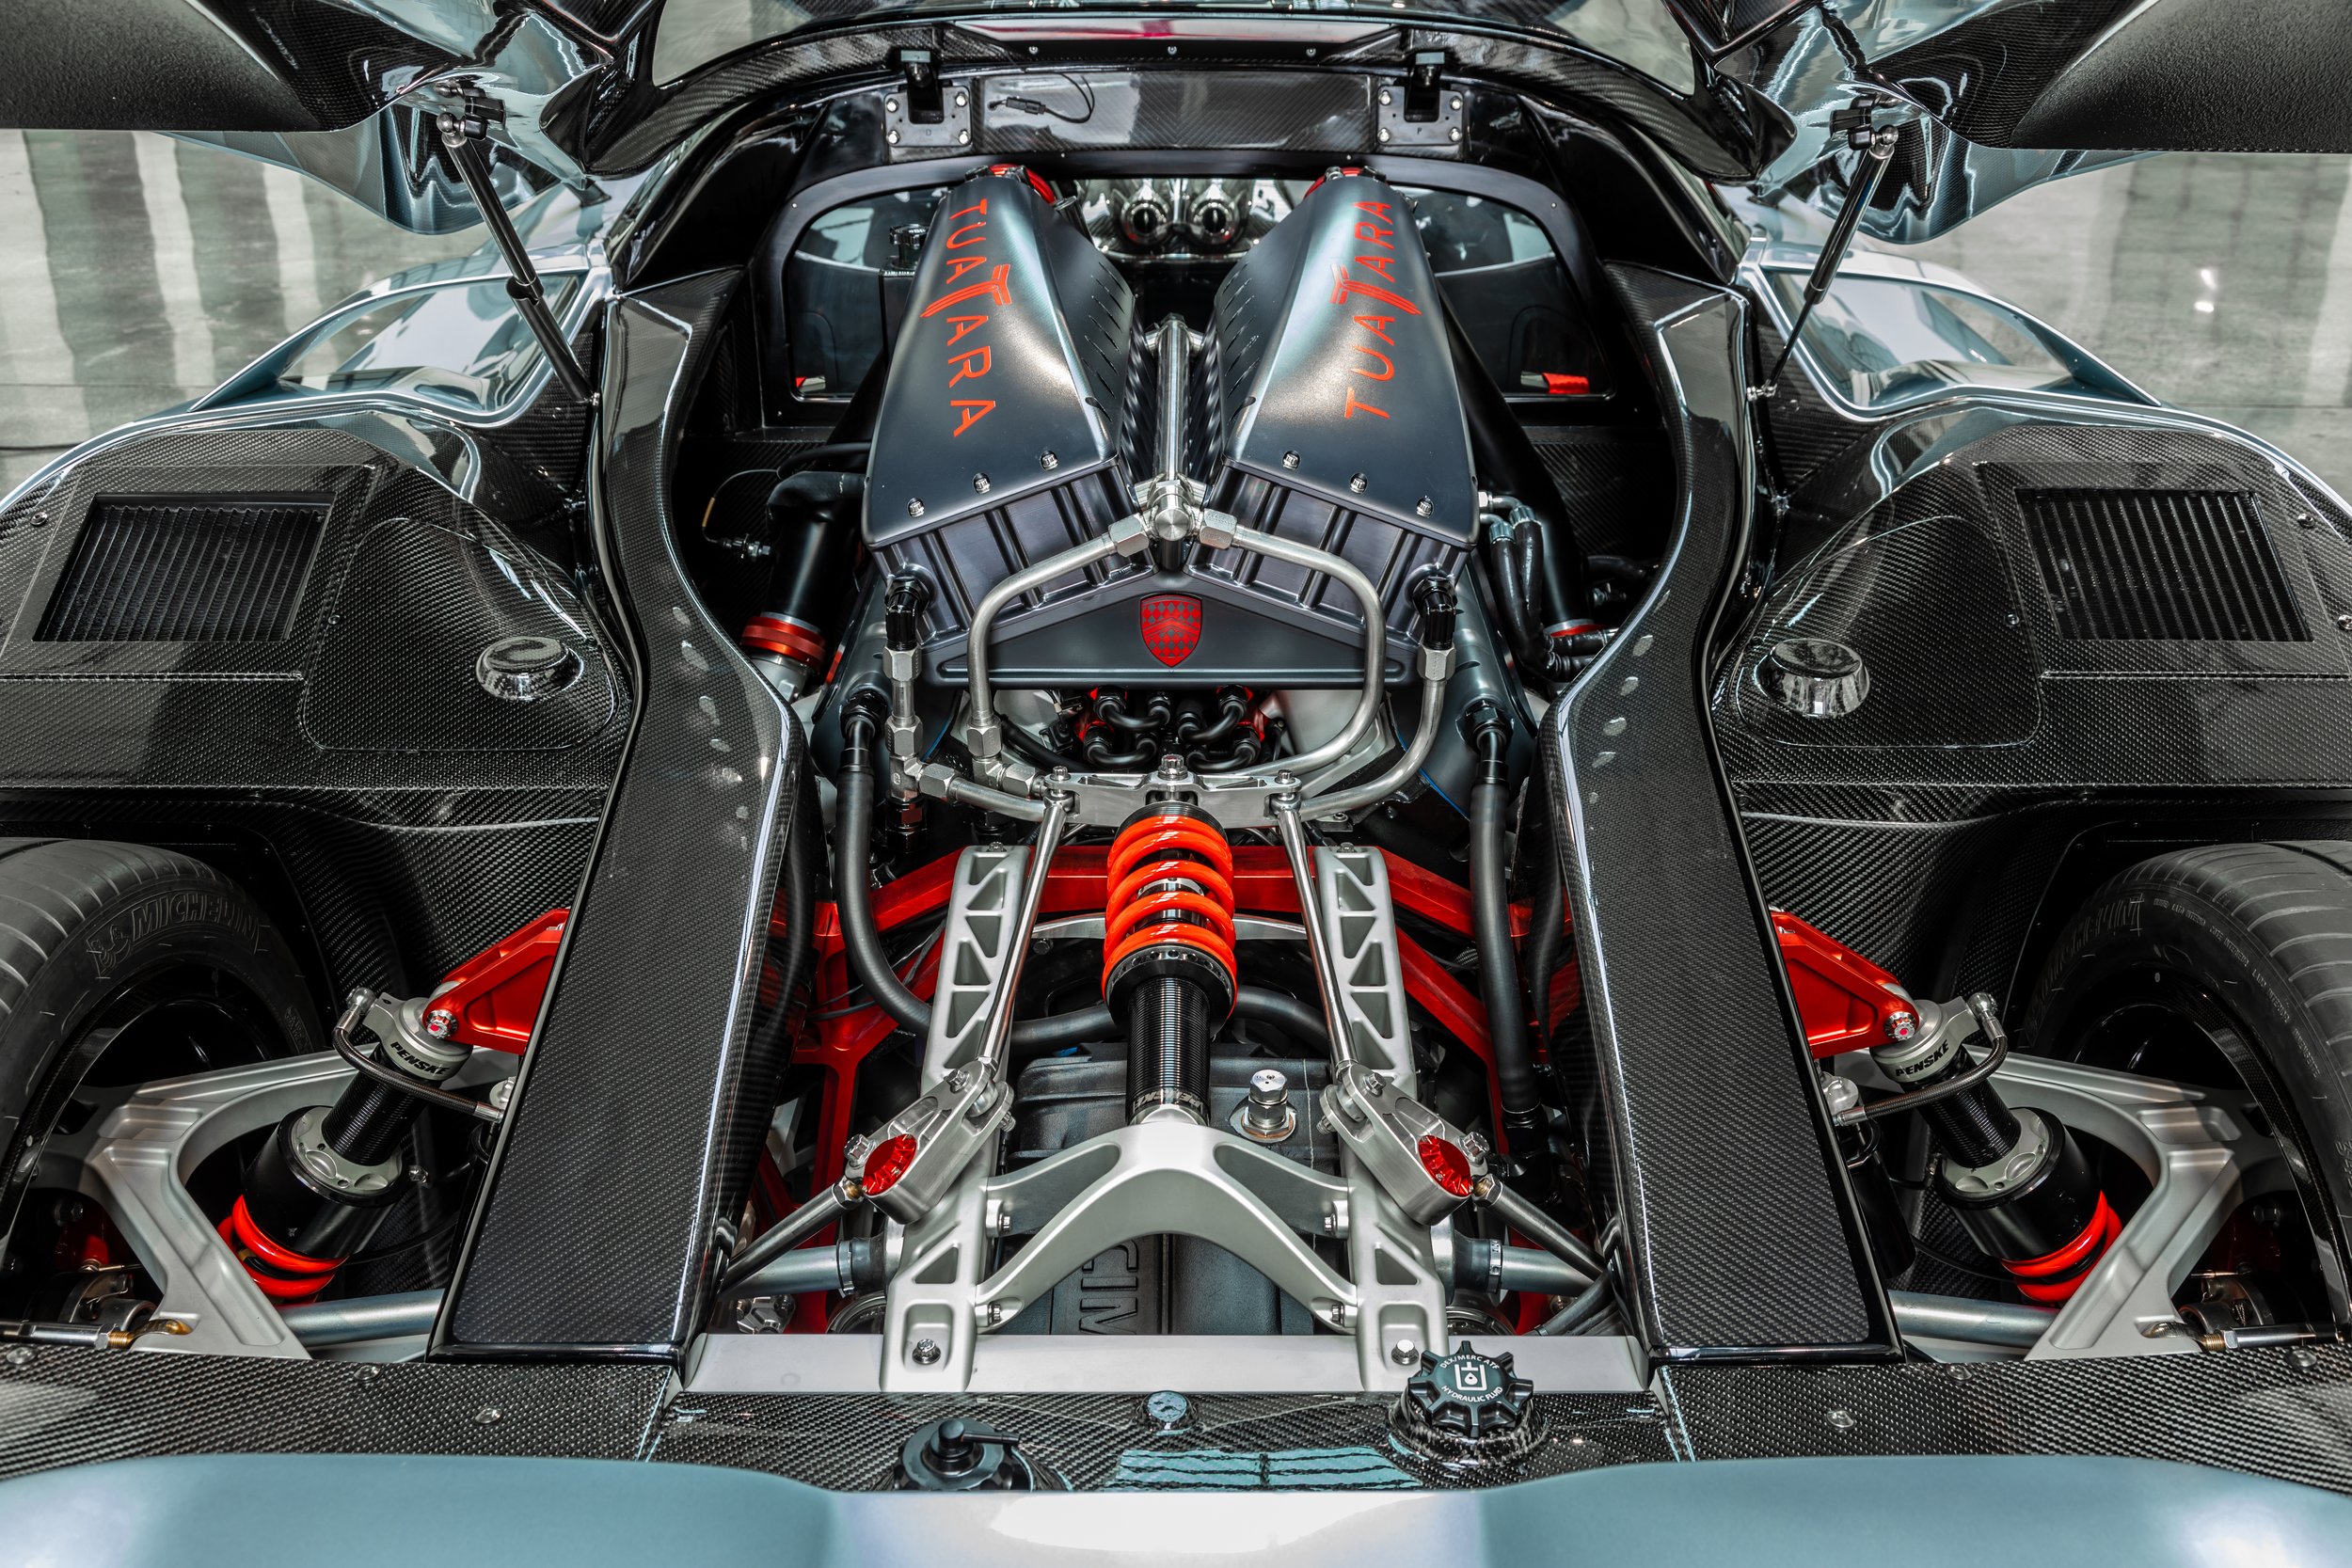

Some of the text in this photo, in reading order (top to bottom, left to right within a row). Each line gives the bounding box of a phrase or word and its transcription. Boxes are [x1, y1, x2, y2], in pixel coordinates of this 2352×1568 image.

[920, 198, 1012, 437] TUATARA
[1330, 200, 1422, 420] TUATARA
[131, 893, 259, 942] MICHELIN
[389, 1041, 452, 1076] PENSKE
[1895, 1039, 1949, 1077] PENSKE
[1439, 1354, 1501, 1370] DEX/MERC ATF
[1441, 1385, 1503, 1402] HYDRAULIC FLUID
